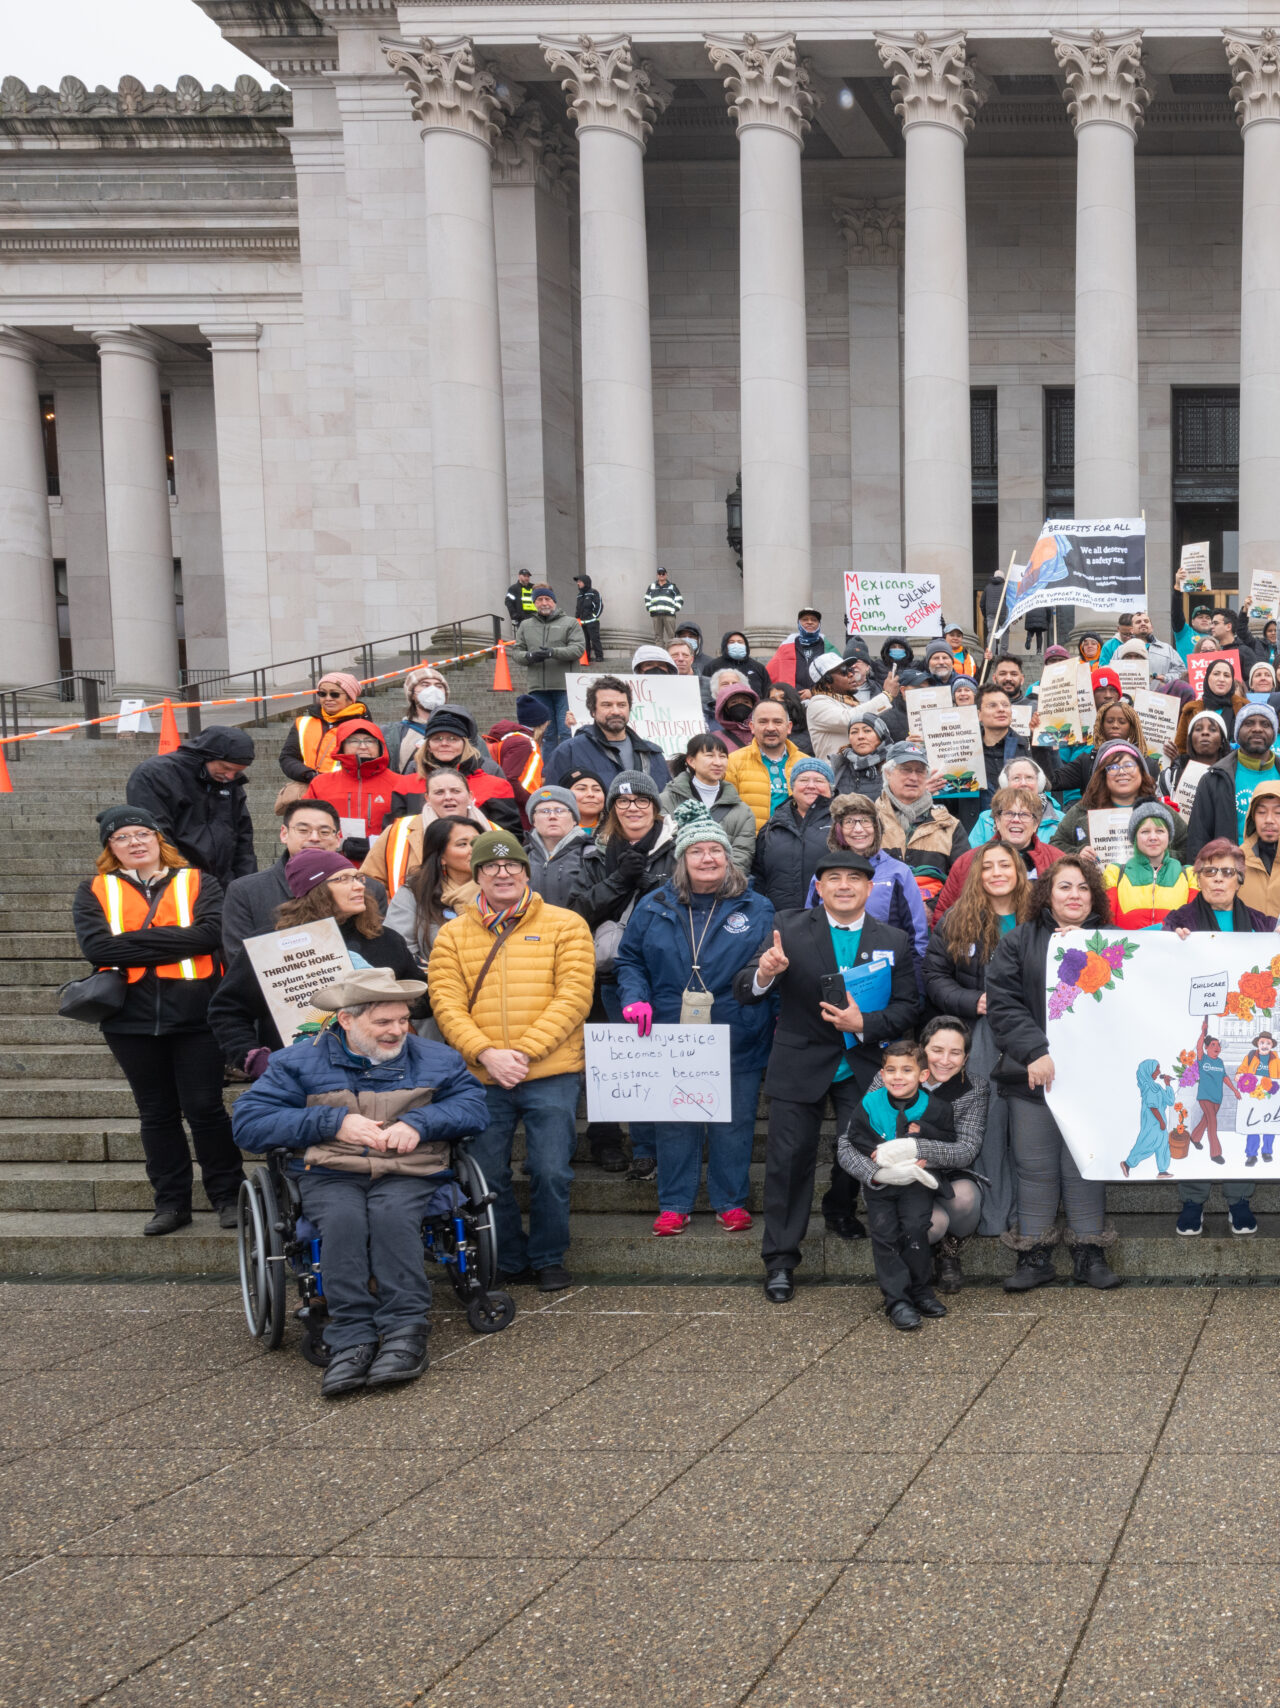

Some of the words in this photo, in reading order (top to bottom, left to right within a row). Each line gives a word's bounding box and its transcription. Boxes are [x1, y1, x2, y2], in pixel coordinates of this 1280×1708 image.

[1092, 557, 1112, 565] safety
[846, 573, 914, 591] Mexicans
[898, 580, 935, 609] SILENCE
[918, 600, 928, 609] IS
[850, 608, 886, 622] Going
[904, 601, 942, 629] BETRAYAL
[296, 949, 316, 960] OUR
[263, 961, 307, 978] THRIVING
[272, 974, 304, 988] asylum
[305, 964, 342, 978] seekers
[285, 980, 318, 994] receive
[319, 975, 335, 984] the
[591, 1029, 634, 1043] When
[649, 1033, 716, 1046] injustice
[610, 1048, 662, 1060] becomes
[670, 1048, 695, 1058] Law
[590, 1066, 661, 1082] Resistance
[672, 1066, 720, 1078] becomes
[672, 1092, 714, 1106] 2025
